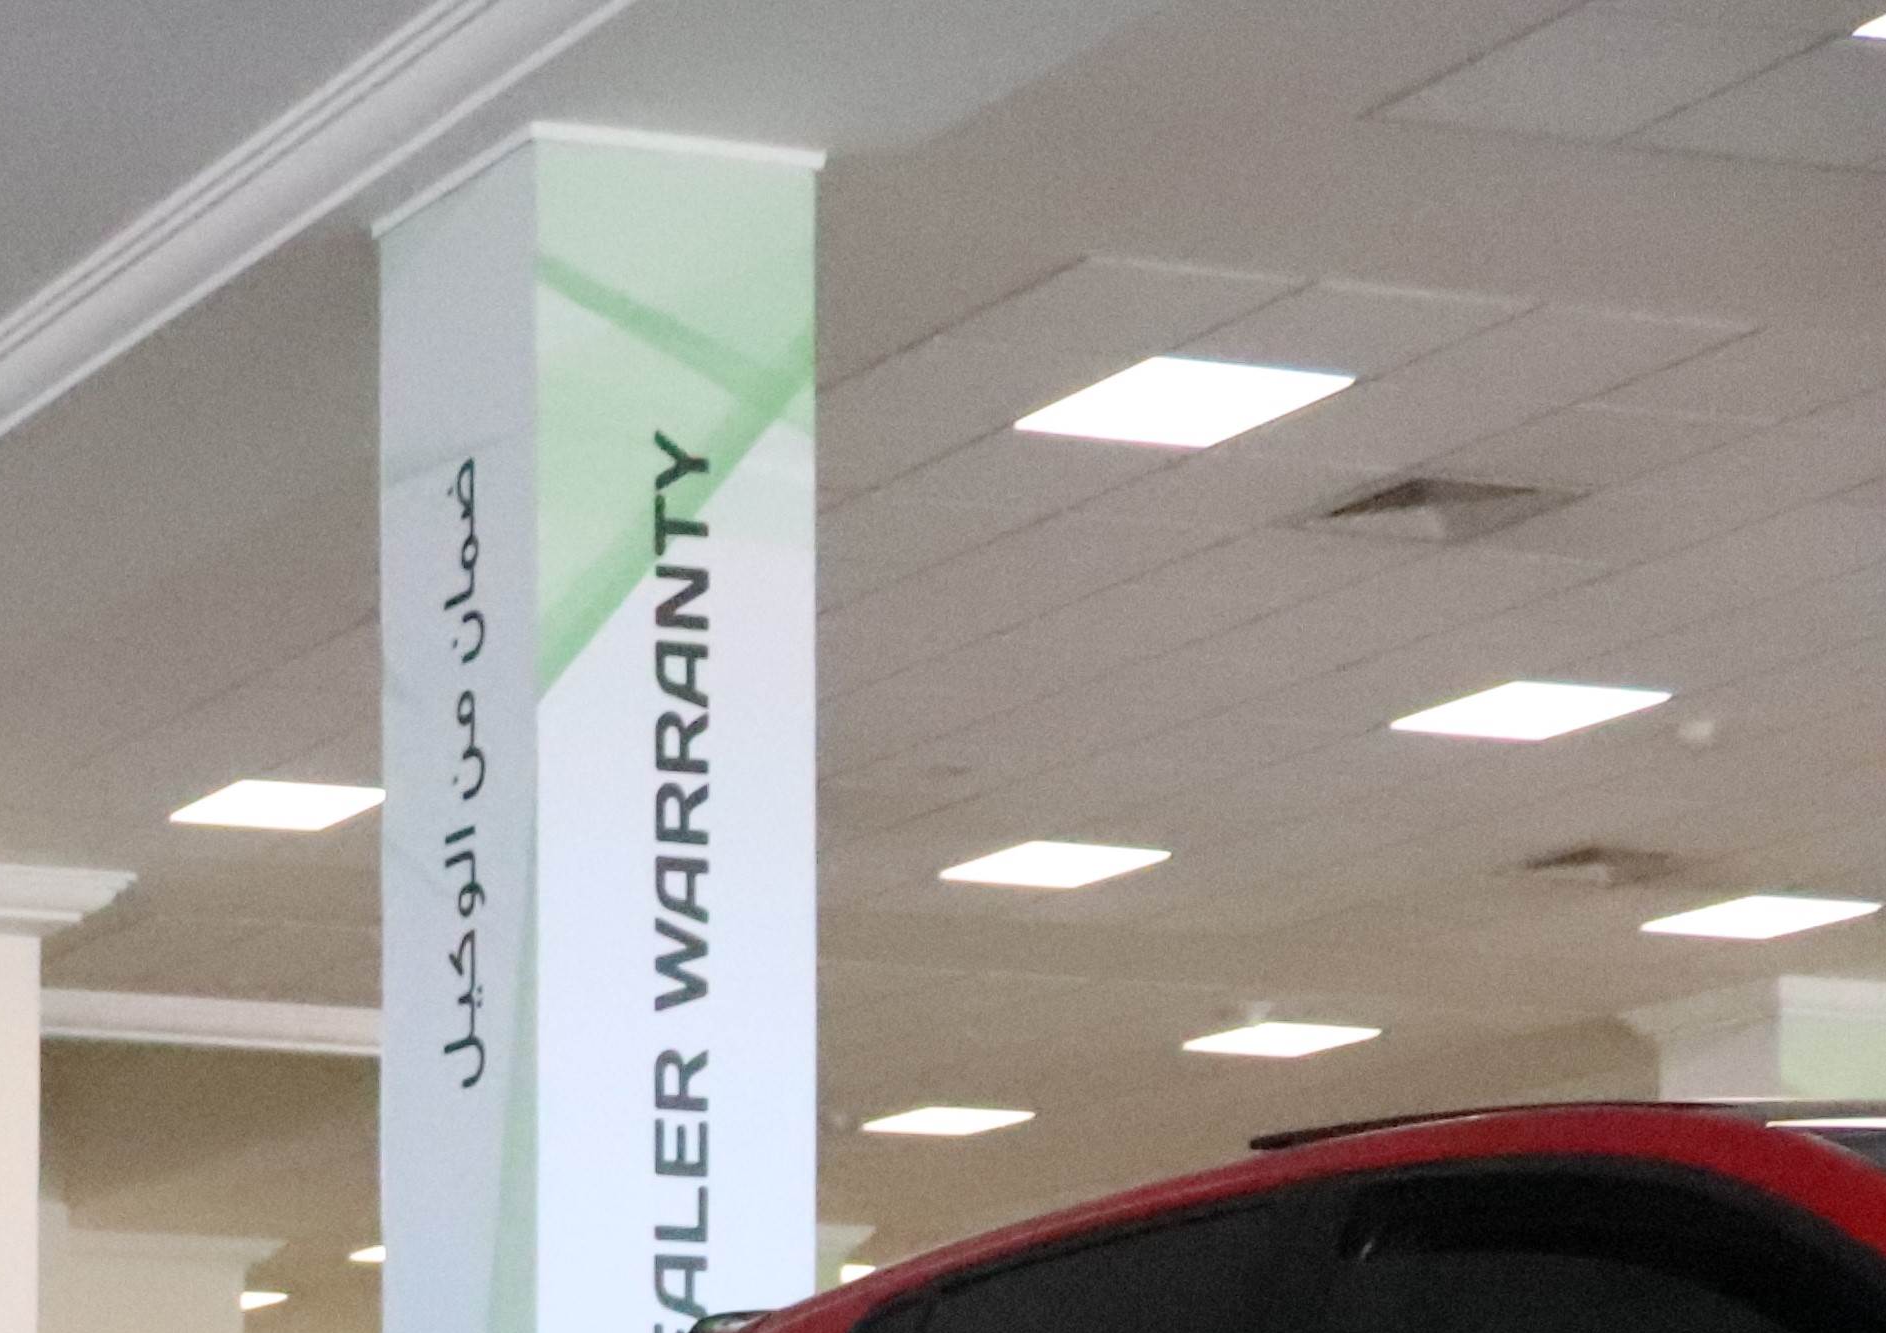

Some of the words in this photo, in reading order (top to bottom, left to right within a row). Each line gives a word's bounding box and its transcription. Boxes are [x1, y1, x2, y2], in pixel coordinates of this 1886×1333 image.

[442, 455, 486, 665] ضمان
[451, 690, 487, 801] من
[653, 429, 710, 1011] WARRANTY
[443, 825, 487, 1090] الوكيل
